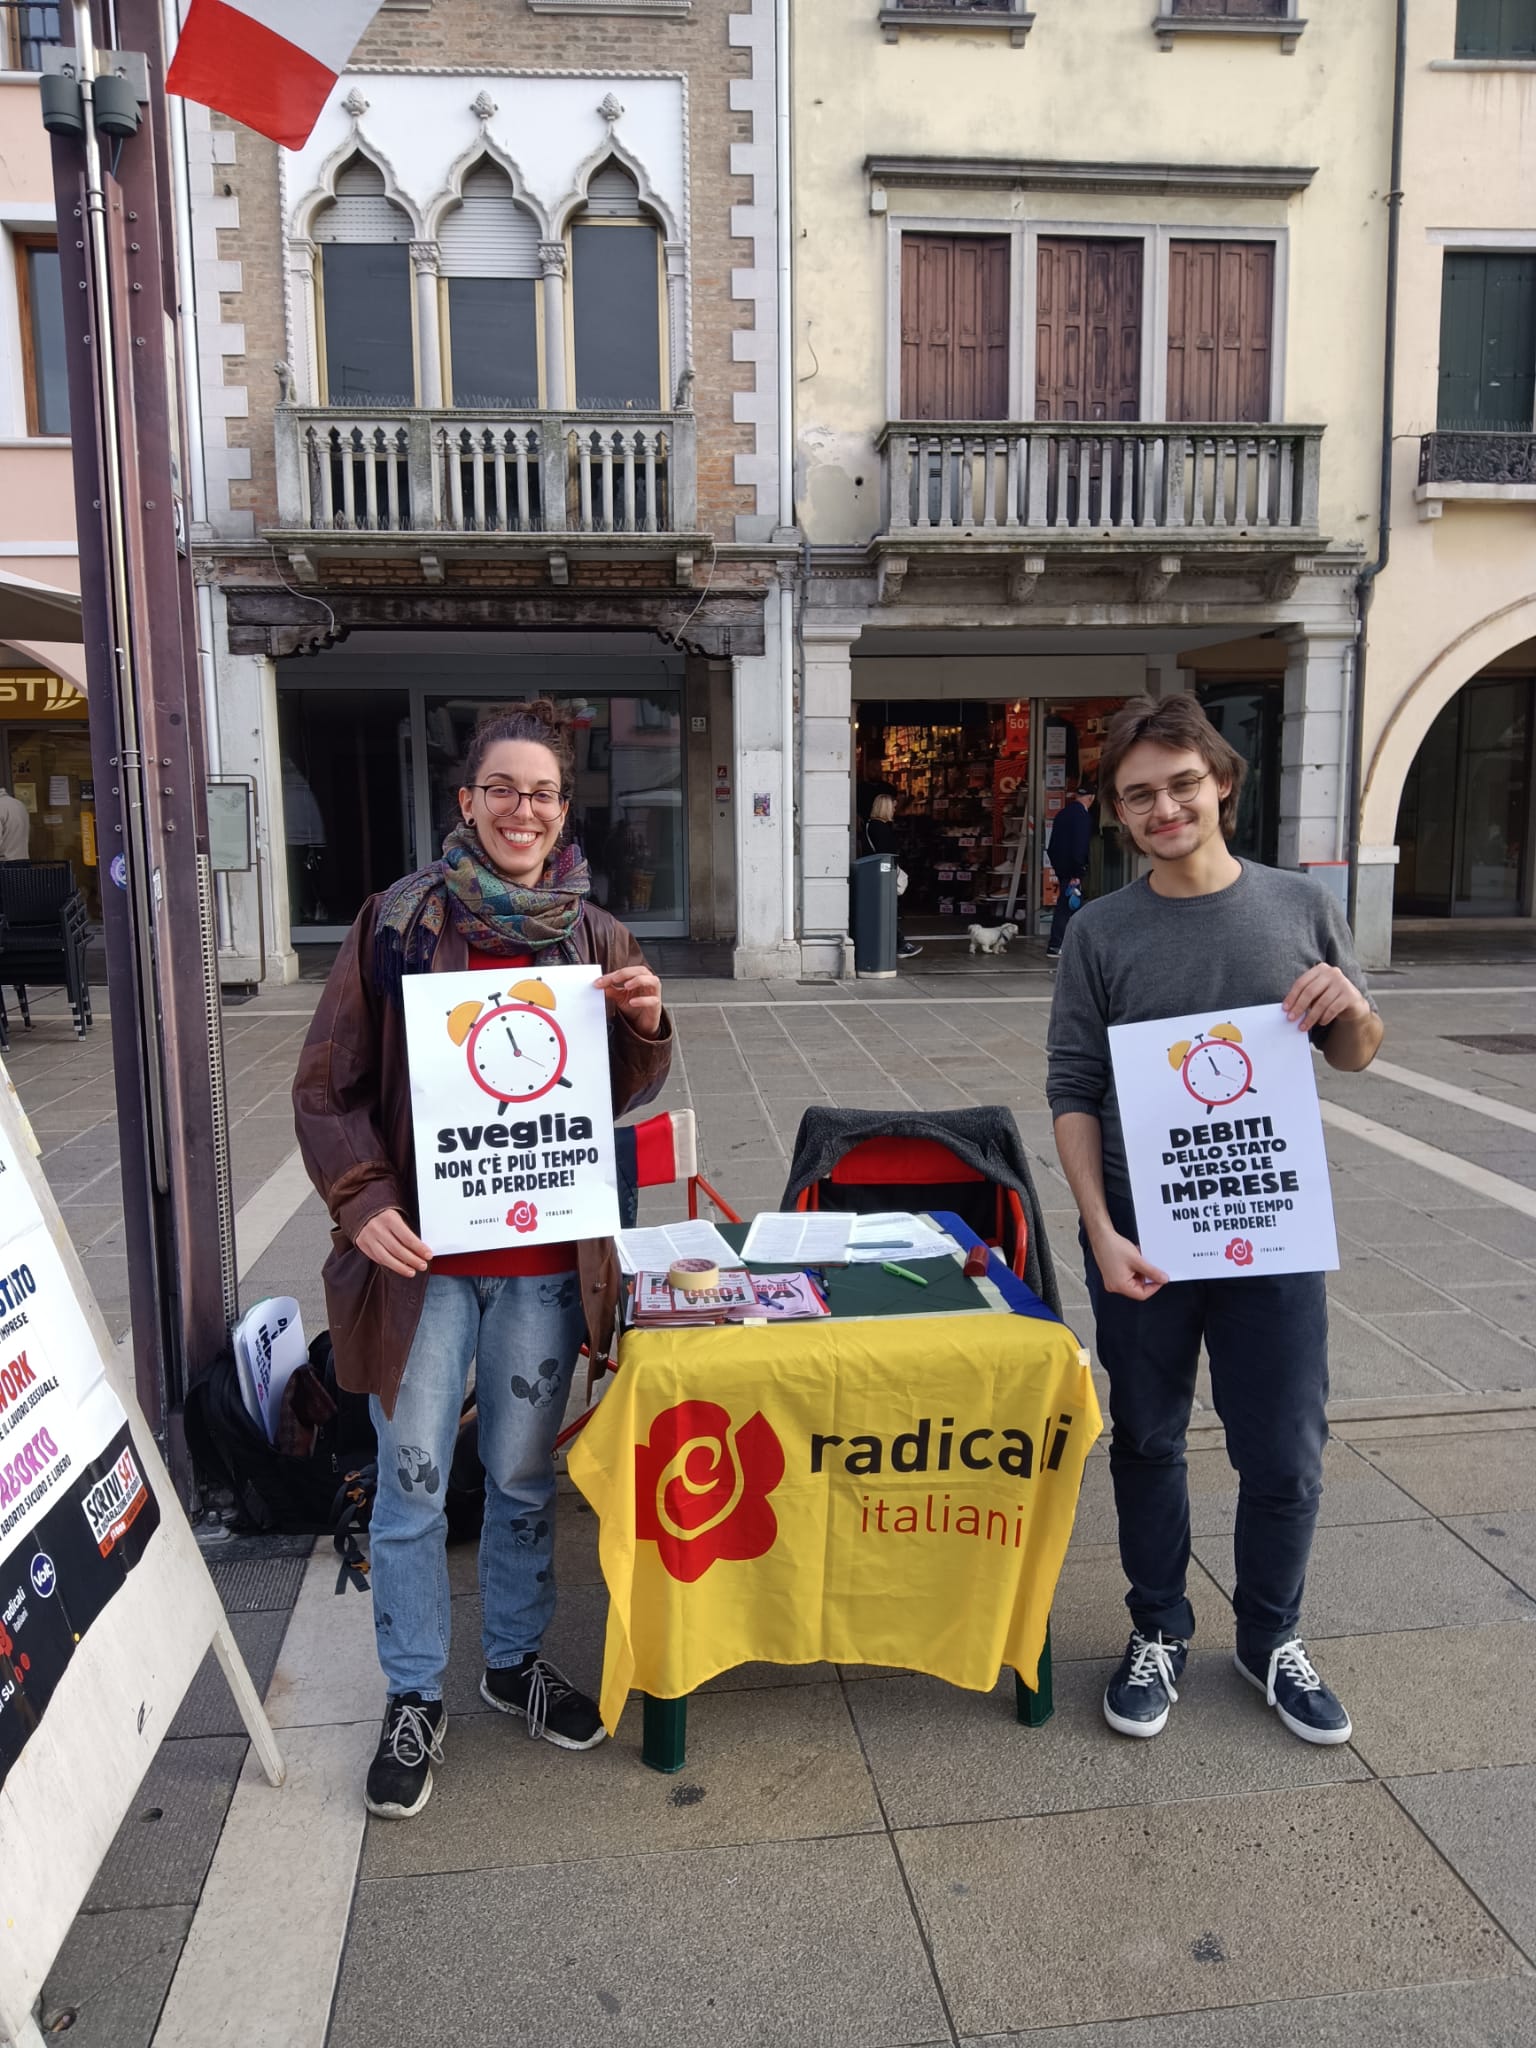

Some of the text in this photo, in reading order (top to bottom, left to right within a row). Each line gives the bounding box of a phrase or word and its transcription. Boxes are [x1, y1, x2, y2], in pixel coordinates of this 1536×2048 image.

[437, 1112, 593, 1154] sveg!ia
[1169, 1116, 1274, 1149] DEBITI
[434, 1147, 599, 1180] NON C'È PIÙ TEMPO
[1162, 1138, 1287, 1166] DELLO STATO
[1180, 1156, 1274, 1179] VERSO LE
[462, 1169, 576, 1198] DA PERDERE!
[1160, 1170, 1300, 1205] IMPRESE
[470, 1216, 500, 1226] RADICALI
[545, 1208, 574, 1218] ITALIANI
[1172, 1205, 1200, 1221] NON
[1225, 1199, 1247, 1215] PIÙ
[1250, 1198, 1294, 1214] TEMPO
[1193, 1214, 1277, 1233] DA PERDERE!
[8, 1400, 31, 1430] LAVORO
[27, 1375, 60, 1409] SESSUALE
[811, 1413, 1073, 1479] radicali
[0, 1426, 59, 1511] ABORTO
[0, 1453, 72, 1538] ABORTO SICURO E LIBERO
[86, 1469, 124, 1529] SCRIVI
[860, 1494, 1025, 1548] italiani
[33, 1562, 54, 1588] Volt
[2, 1586, 26, 1625] radicali
